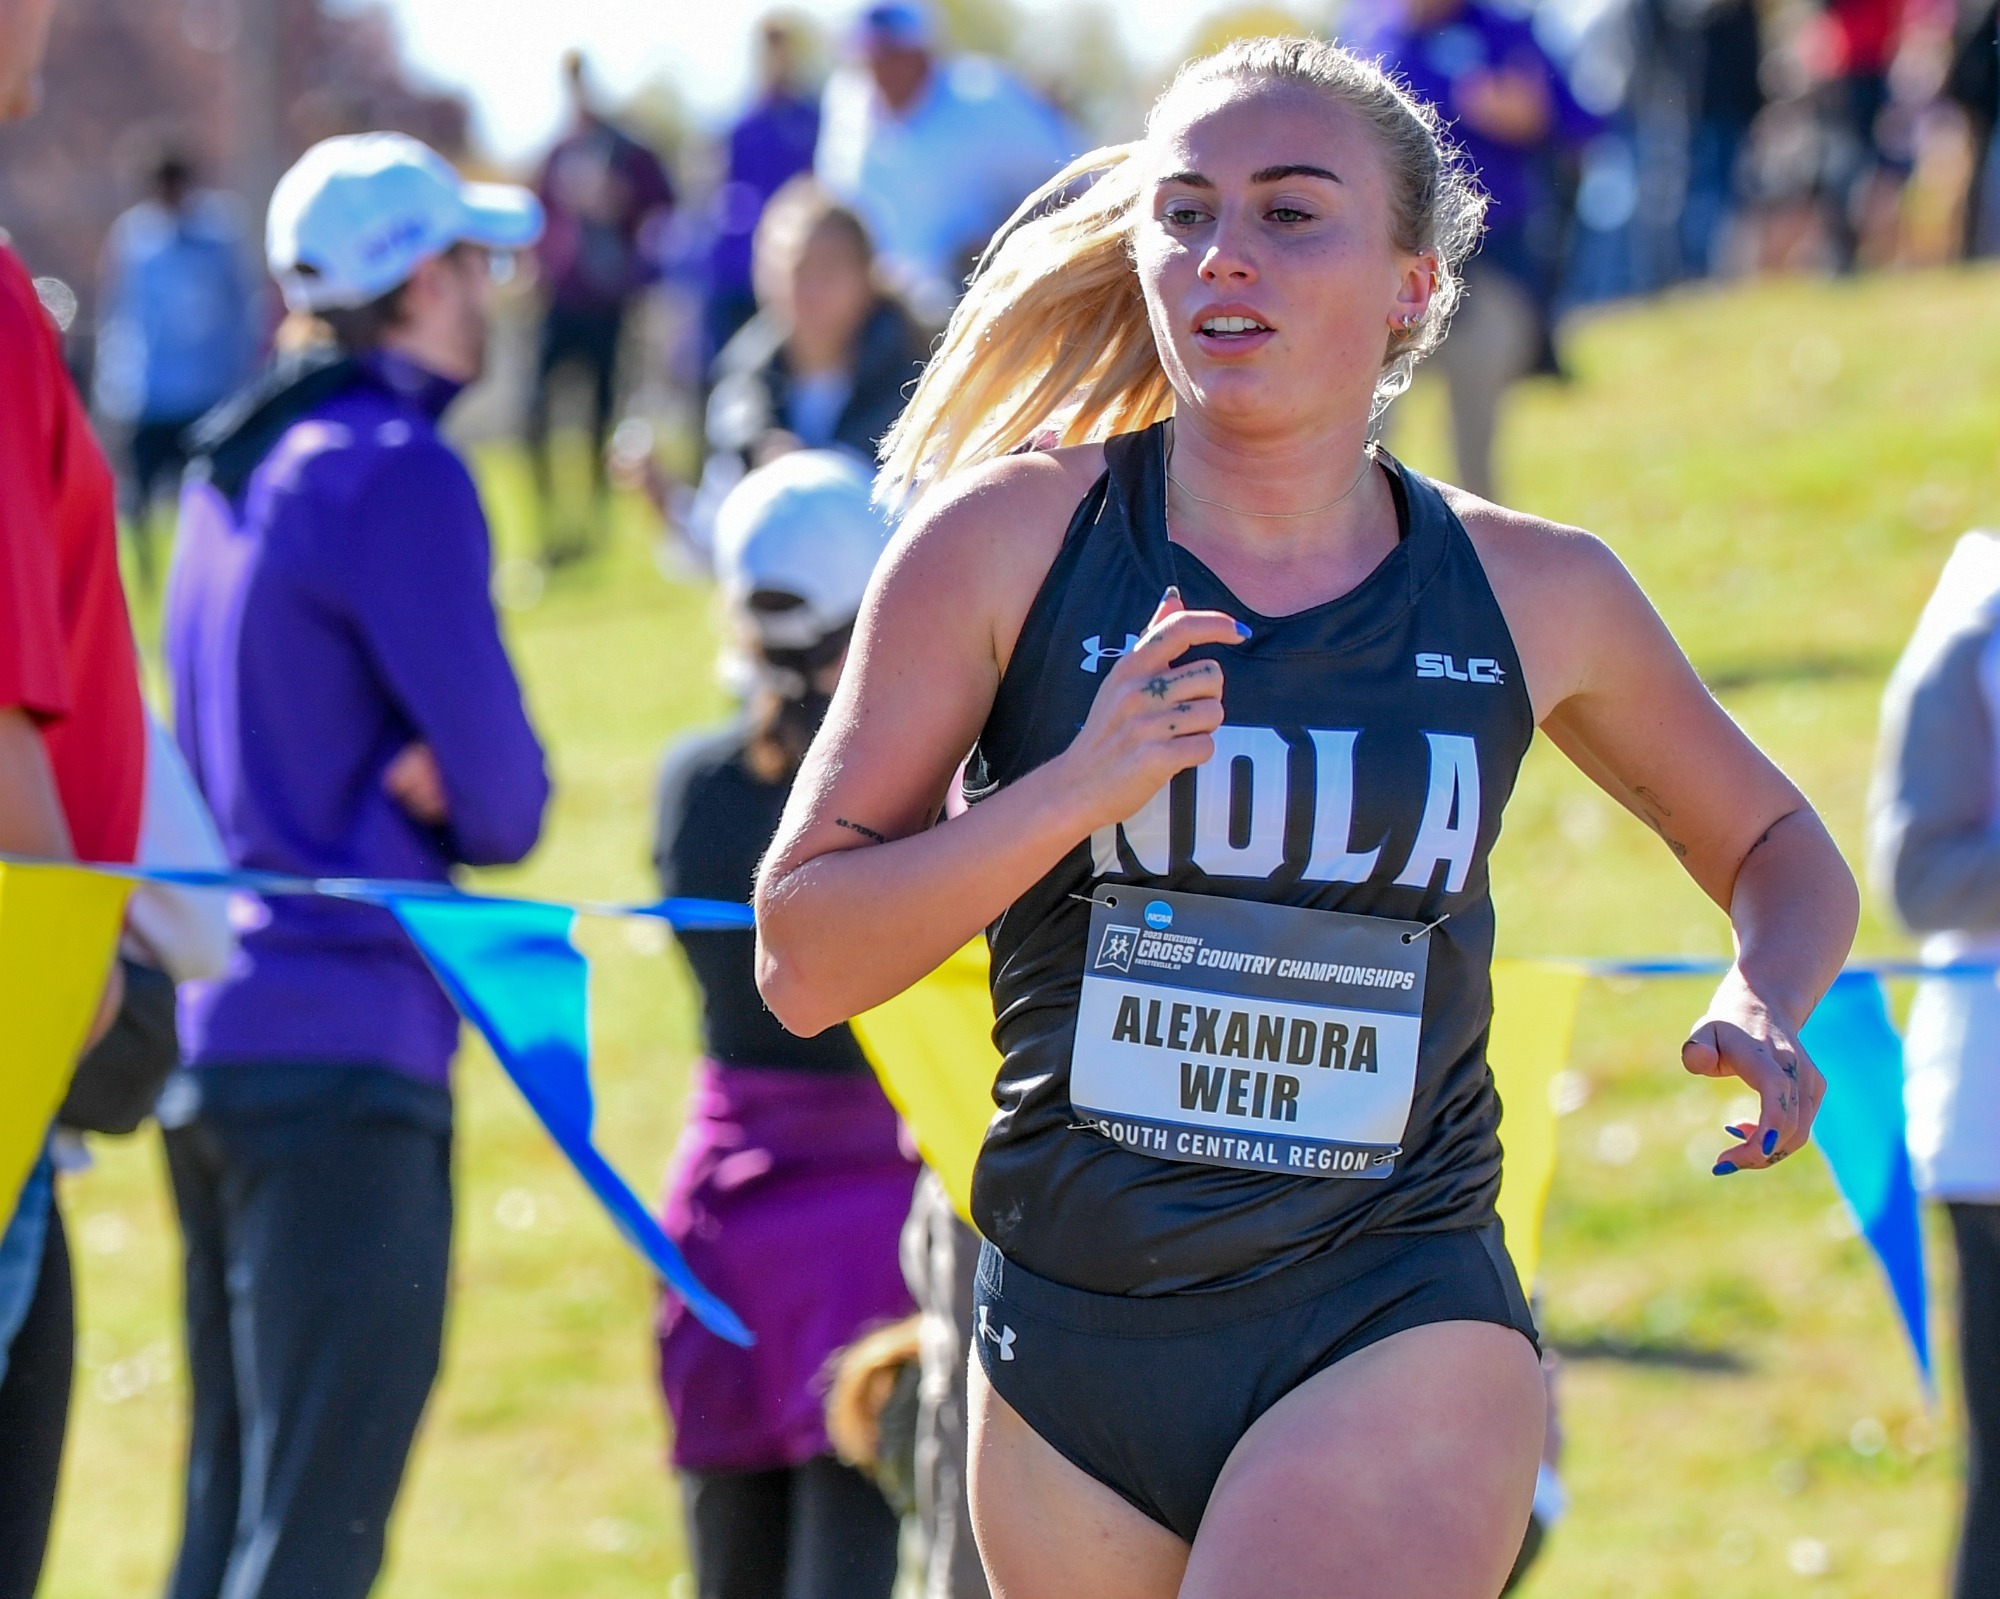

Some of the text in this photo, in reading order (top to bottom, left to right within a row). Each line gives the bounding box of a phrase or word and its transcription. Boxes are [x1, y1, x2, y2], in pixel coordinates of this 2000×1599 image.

[1415, 652, 1497, 684] SLC
[1142, 930, 1163, 940] 2023
[1163, 932, 1198, 945] DIVISION
[1147, 912, 1172, 924] NCAA
[1137, 939, 1415, 991] CROSS COUNTRY CHAMPIONSHIPS
[1111, 995, 1379, 1074] ALEXANDRA
[1178, 1063, 1301, 1123] WEIR
[1098, 1119, 1370, 1172] SOUTH CENTRAL REGION
